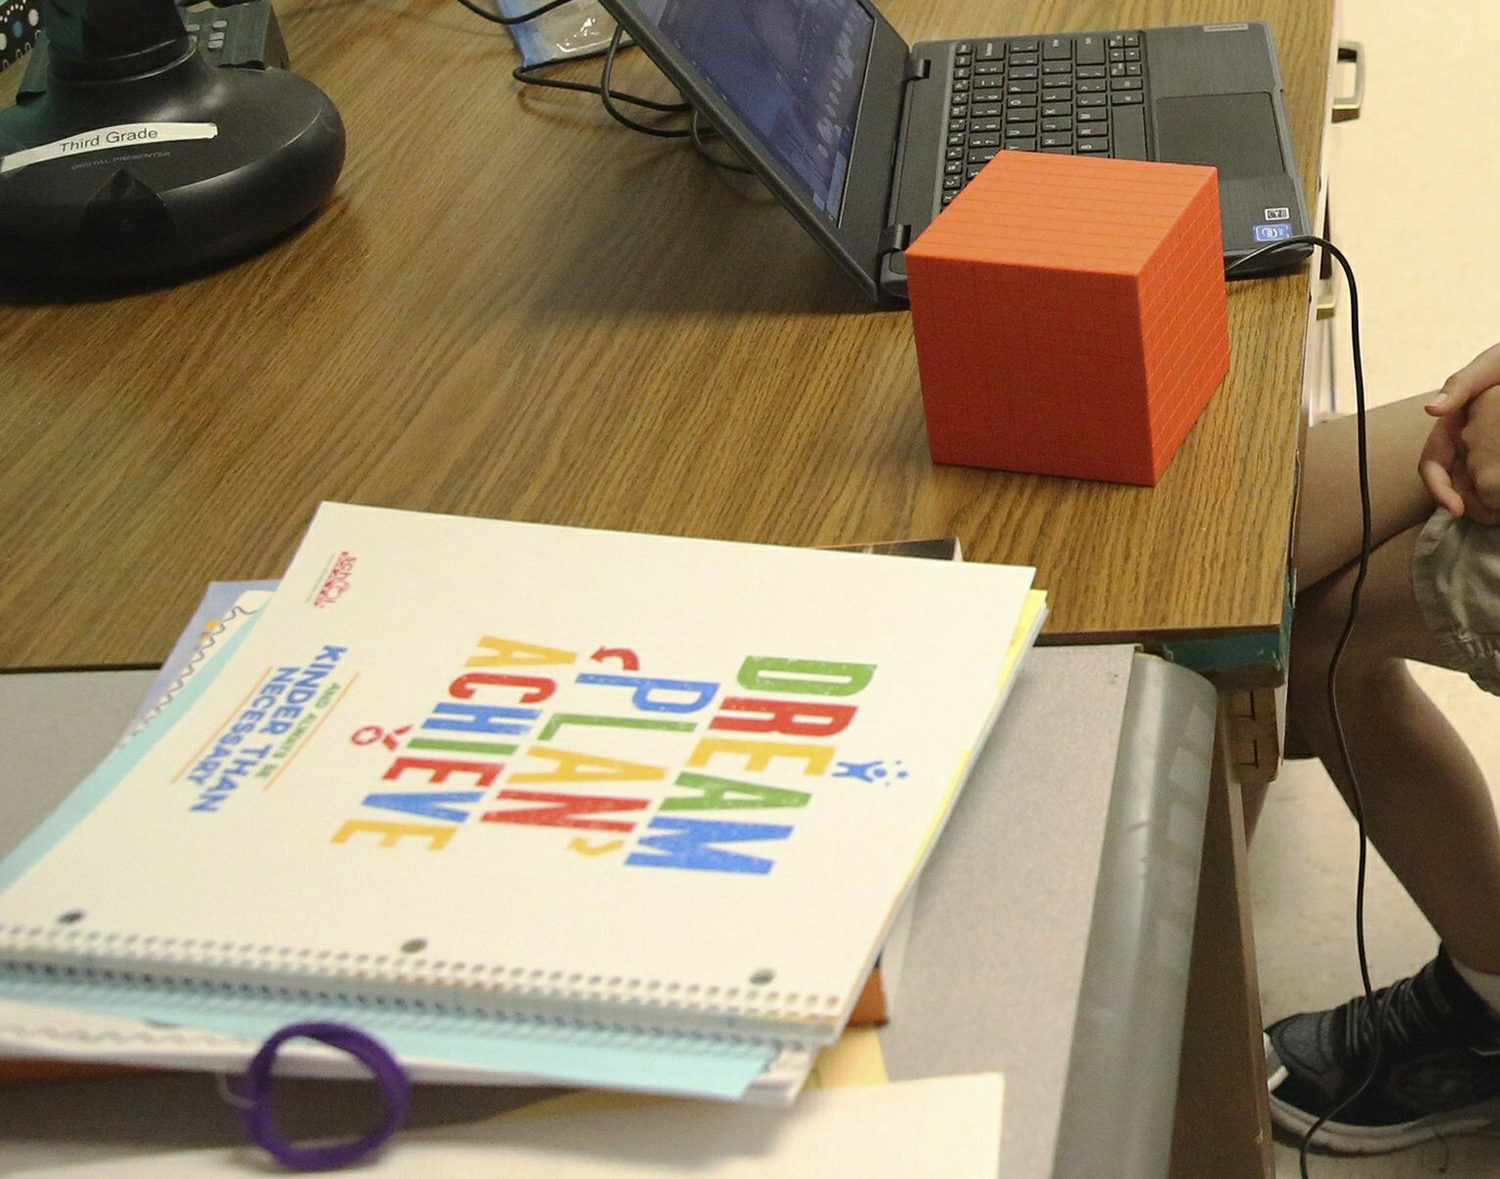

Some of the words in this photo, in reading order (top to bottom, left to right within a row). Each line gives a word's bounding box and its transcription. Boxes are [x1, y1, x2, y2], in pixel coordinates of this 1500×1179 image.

[60, 134, 100, 153] Third
[105, 127, 158, 143] Grade
[187, 667, 301, 785] NECESSARY
[259, 645, 348, 736] KINDER
[314, 682, 341, 709] AND
[189, 744, 273, 813] THAN
[330, 635, 578, 851] ACHIEVE
[480, 672, 721, 834] PLAN
[625, 655, 878, 875] DREAM
